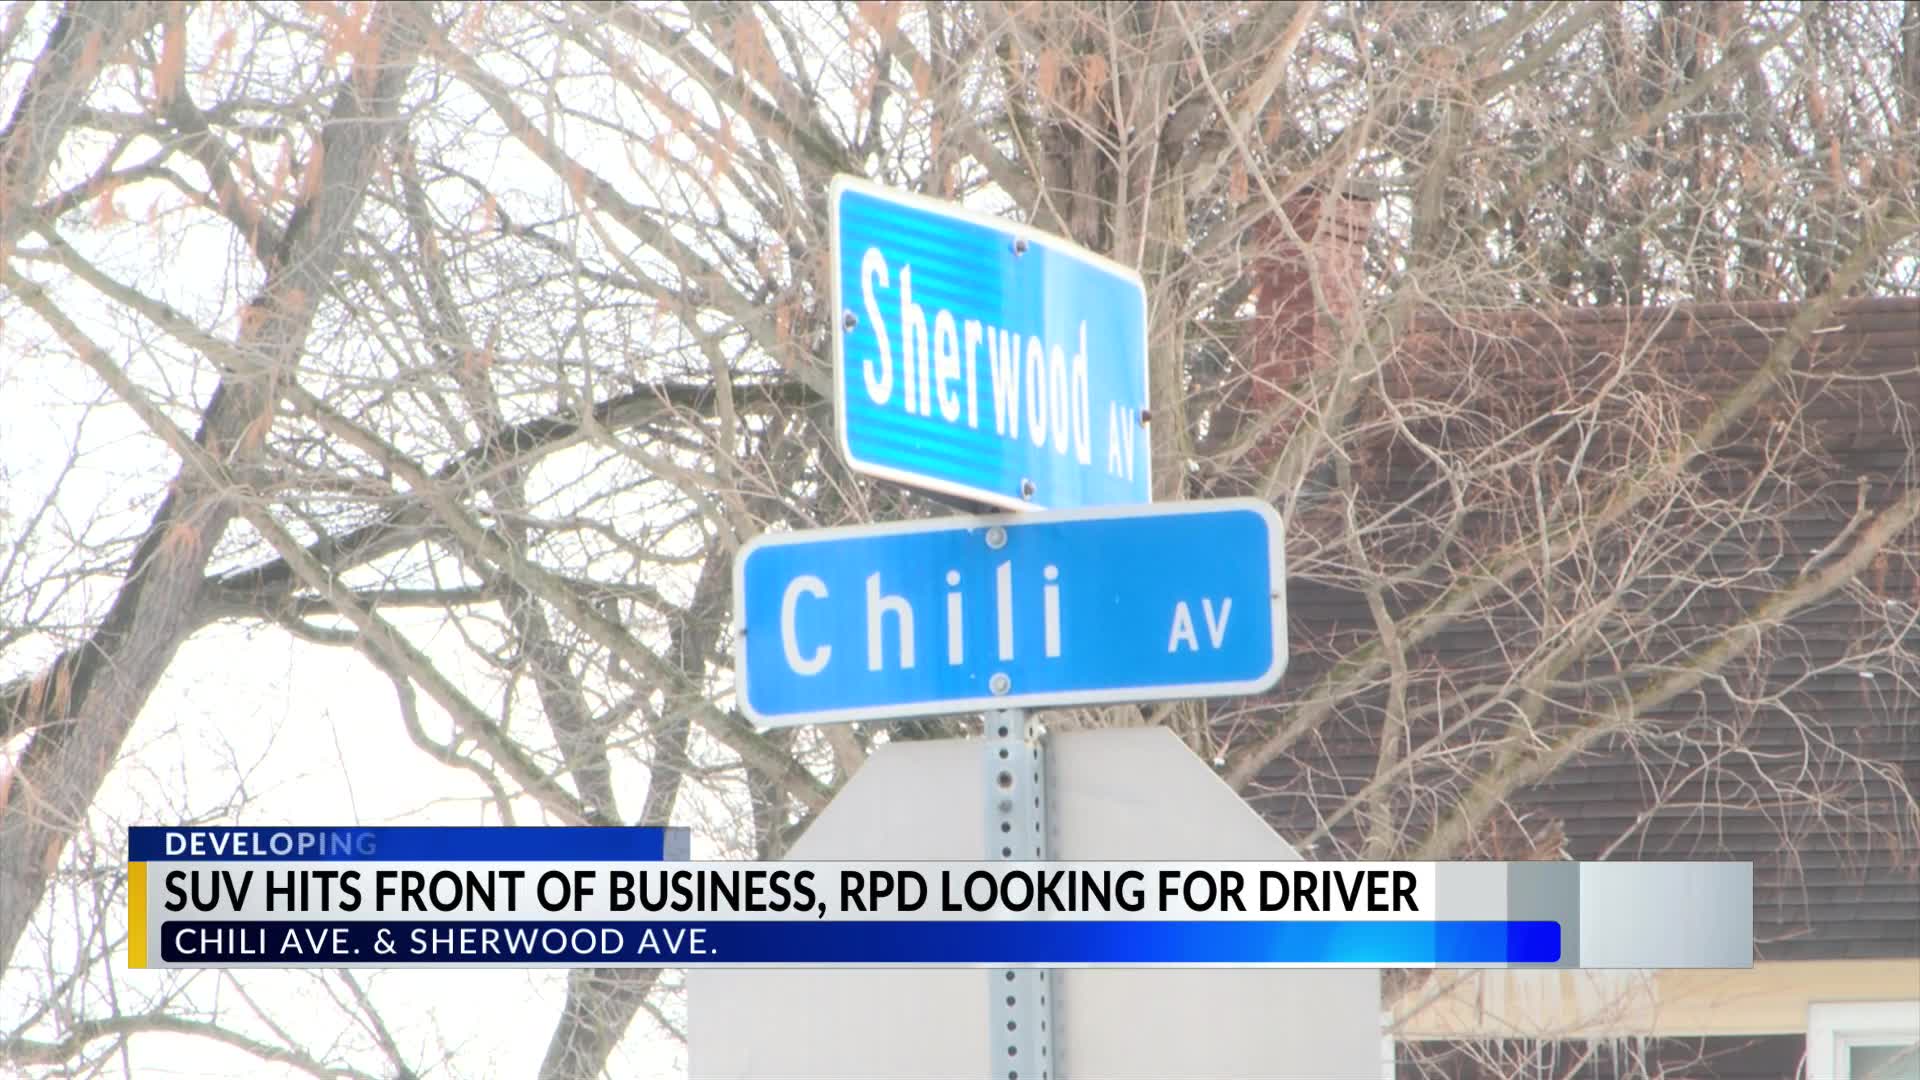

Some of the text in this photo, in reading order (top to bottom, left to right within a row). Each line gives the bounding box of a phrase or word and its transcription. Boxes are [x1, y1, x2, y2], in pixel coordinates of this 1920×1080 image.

[860, 247, 1136, 482] Sherwood AV
[780, 560, 1233, 676] Chili AV
